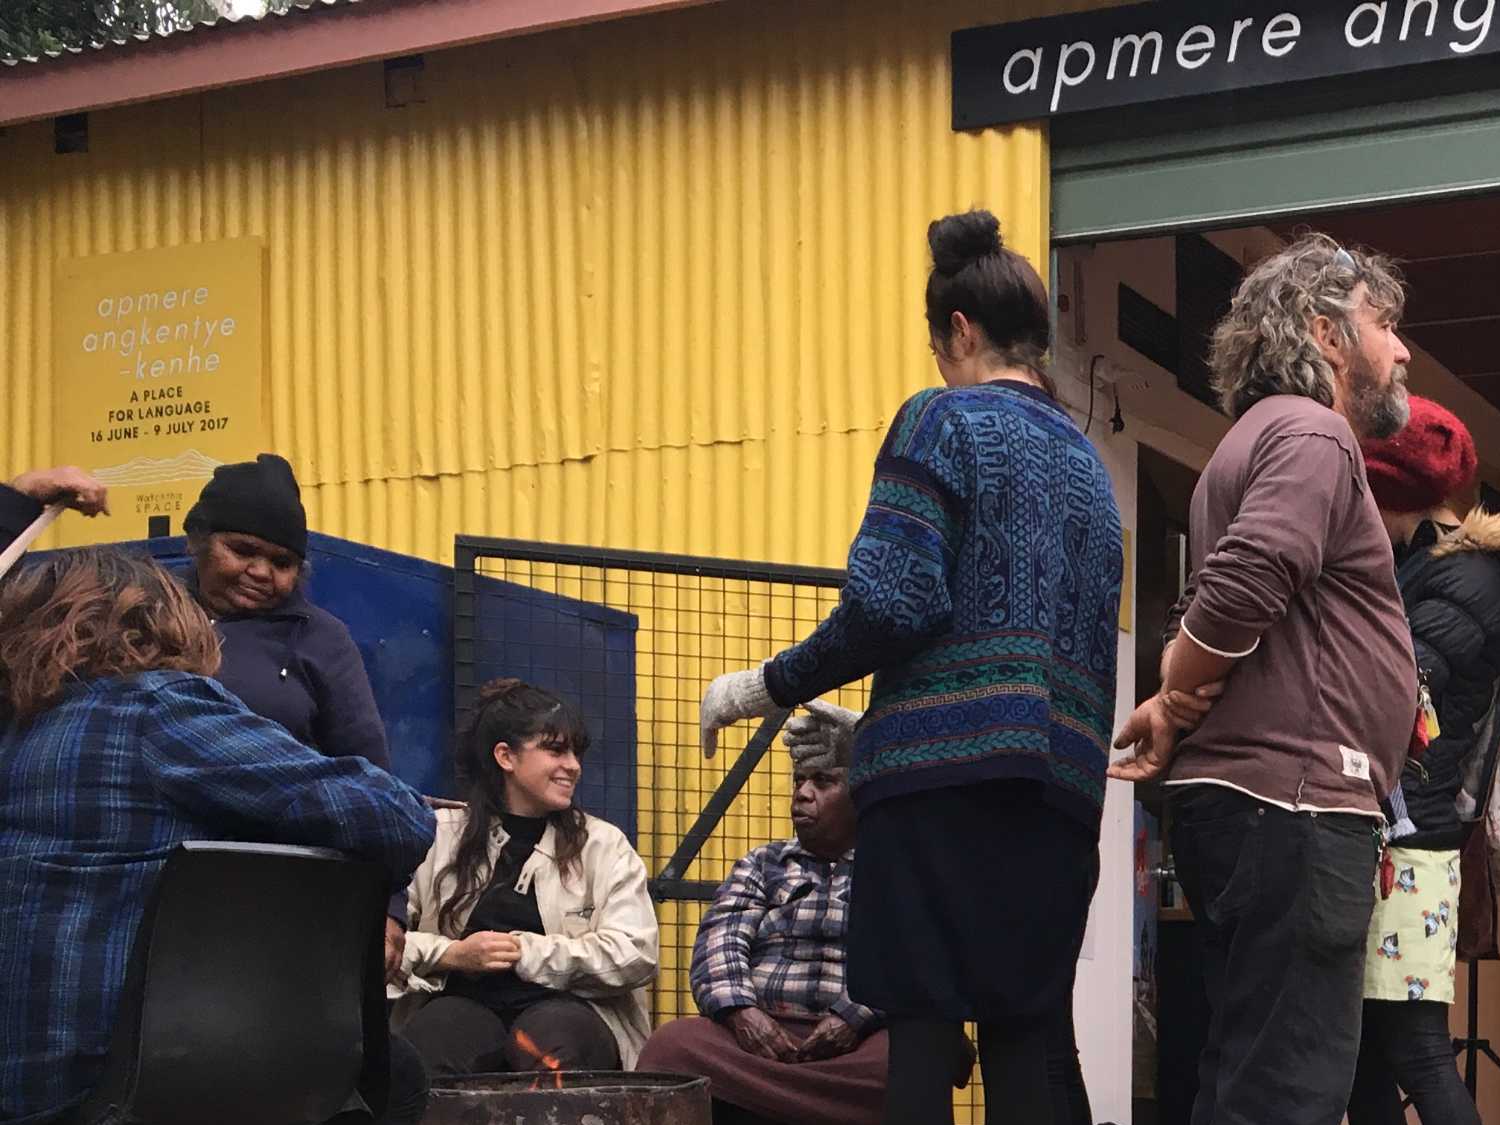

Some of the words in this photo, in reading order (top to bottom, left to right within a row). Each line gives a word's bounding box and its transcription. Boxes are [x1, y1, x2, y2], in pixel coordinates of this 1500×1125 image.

[1003, 12, 1300, 112] apmere
[98, 288, 209, 321] apmere
[82, 315, 236, 357] angkentye
[119, 344, 220, 380] -kenhe
[108, 409, 133, 422] FOR
[138, 400, 211, 420] LANGUAGE
[130, 390, 139, 403] A
[143, 386, 183, 401] PLACE
[91, 430, 103, 443] 16
[107, 427, 139, 441] JUNE
[153, 425, 161, 436] 9
[166, 421, 194, 435] JULY
[200, 417, 229, 431] 2017
